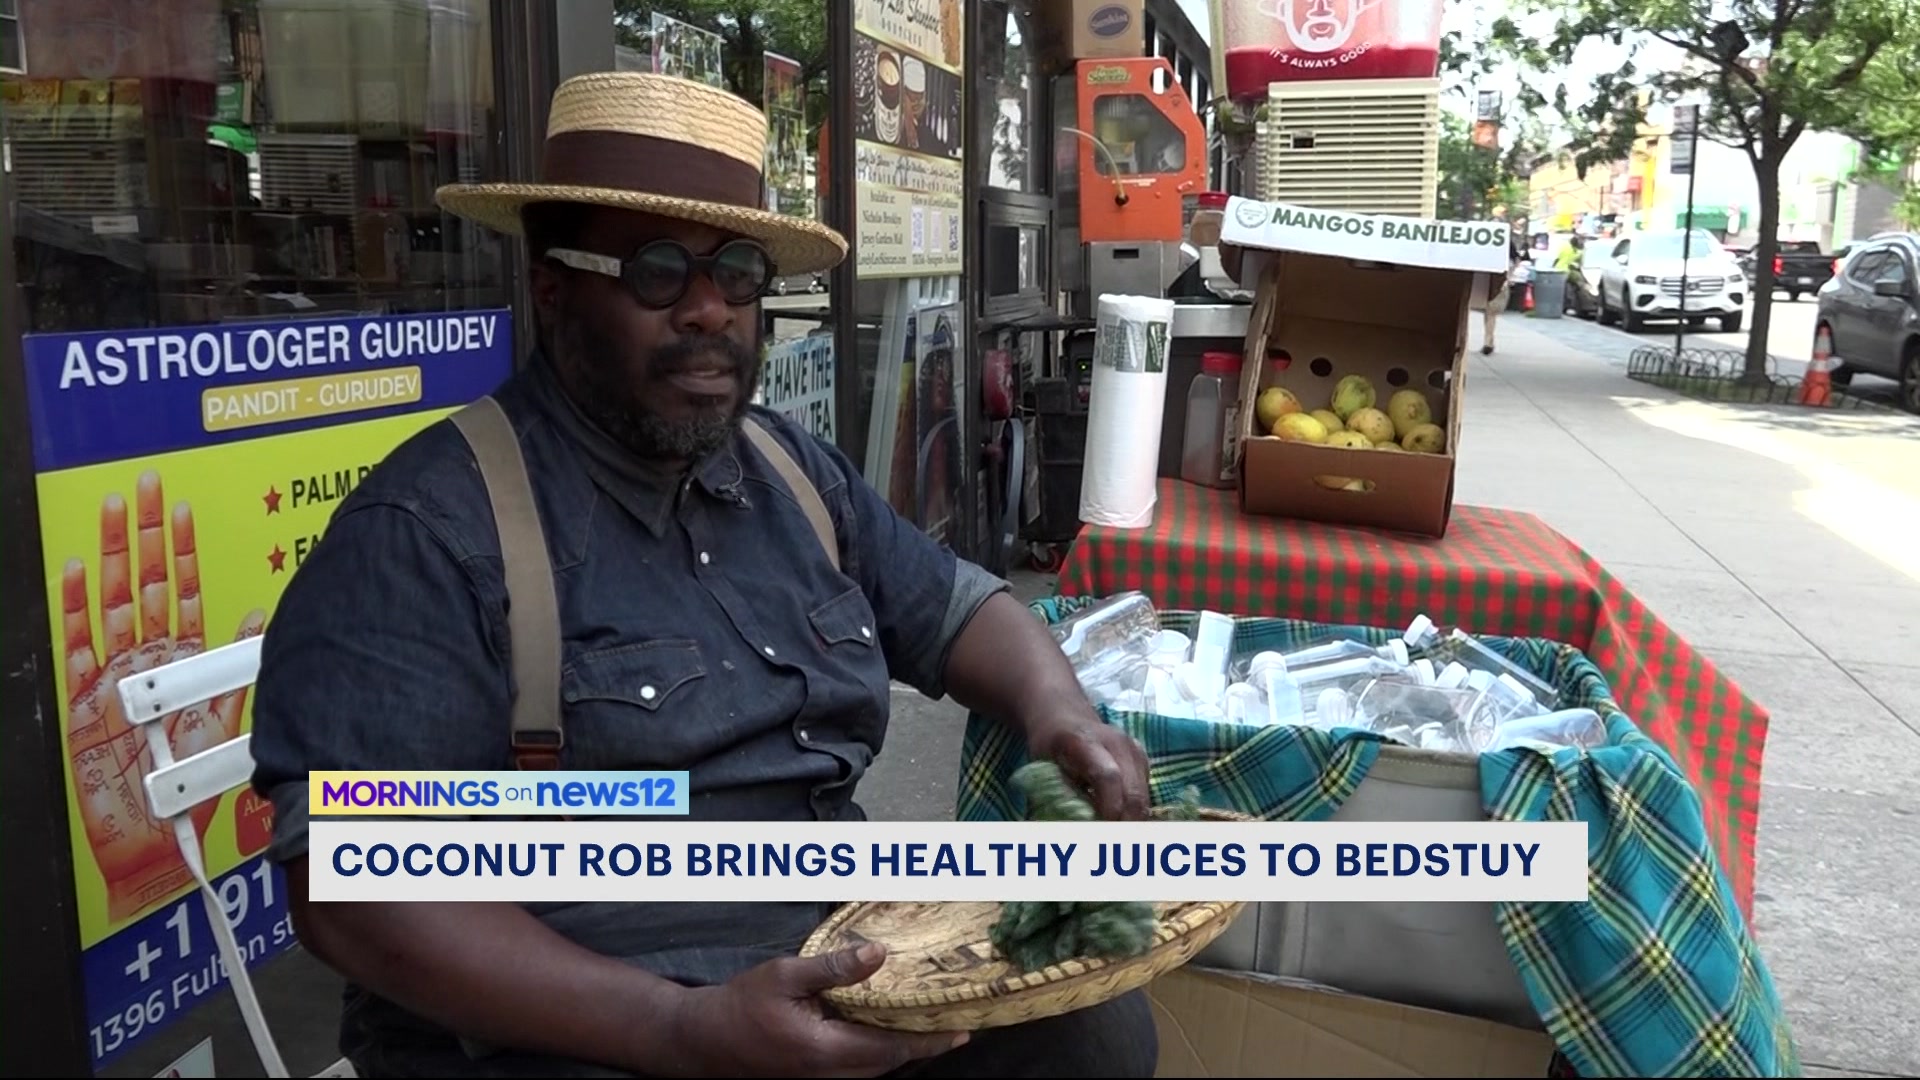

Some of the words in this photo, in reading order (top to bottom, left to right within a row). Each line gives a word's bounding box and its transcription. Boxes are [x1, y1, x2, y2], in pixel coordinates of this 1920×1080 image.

[1269, 47, 1289, 63] IT'S
[1290, 57, 1337, 68] ALWAYS
[1340, 41, 1372, 63] GOOD
[1272, 207, 1374, 237] MANGOS
[1381, 221, 1506, 247] BANILEJOS
[59, 324, 350, 389] ASTROLOGER
[360, 315, 497, 360] GURUDEV
[775, 351, 808, 404] HAVE
[811, 346, 831, 392] THE
[206, 387, 300, 423] PANDIT
[319, 373, 419, 407] GURUDEV
[810, 398, 832, 438] TEA
[291, 469, 352, 508] PALM
[125, 901, 191, 983] +1
[217, 858, 274, 930] 91
[90, 989, 165, 1059] 1396
